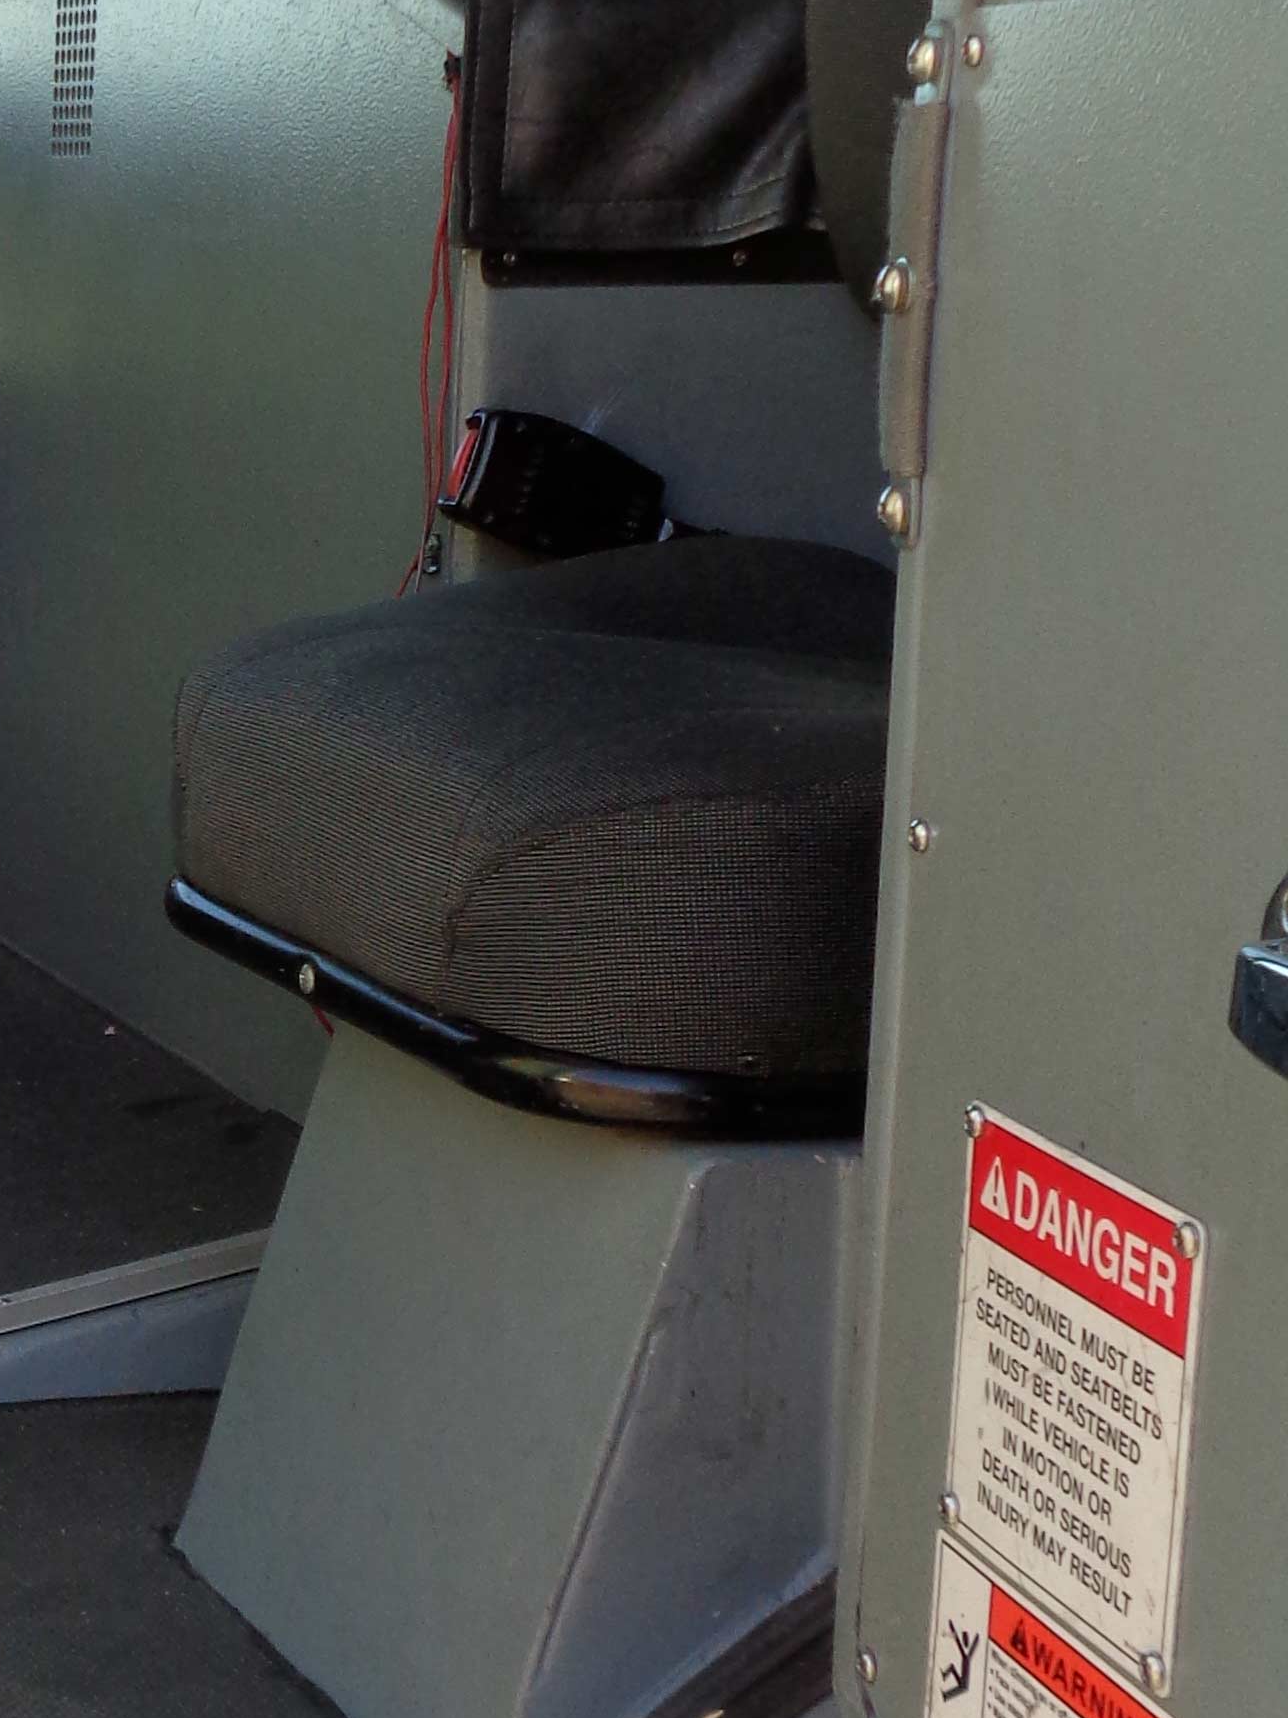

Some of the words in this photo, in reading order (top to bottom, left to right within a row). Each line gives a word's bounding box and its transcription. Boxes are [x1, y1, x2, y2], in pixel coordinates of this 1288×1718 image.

[1013, 1169, 1177, 1318] DANGER
[976, 1297, 1030, 1351] SEATED
[1034, 1338, 1067, 1375] AND
[1070, 1361, 1162, 1440] SEATBELTS
[987, 1267, 1076, 1345] PERSONNEL
[1080, 1328, 1128, 1376] MUST
[1132, 1362, 1155, 1395] BE
[988, 1342, 1029, 1388] MUST
[1033, 1373, 1053, 1406] BE
[1057, 1390, 1141, 1465] FASTENED
[993, 1385, 1039, 1434] WHILE
[1042, 1417, 1110, 1485] VEHICLE
[1114, 1467, 1130, 1498] IS
[982, 1448, 1029, 1503] DEATH
[1033, 1487, 1056, 1523] OR
[1060, 1505, 1131, 1578] SERIOUS
[1003, 1426, 1017, 1457] IN
[1021, 1440, 1084, 1506] MOTION
[1088, 1489, 1112, 1525] OR
[977, 1481, 1029, 1540] INJURY
[1033, 1524, 1066, 1567] MAY
[1070, 1552, 1132, 1617] RESULT
